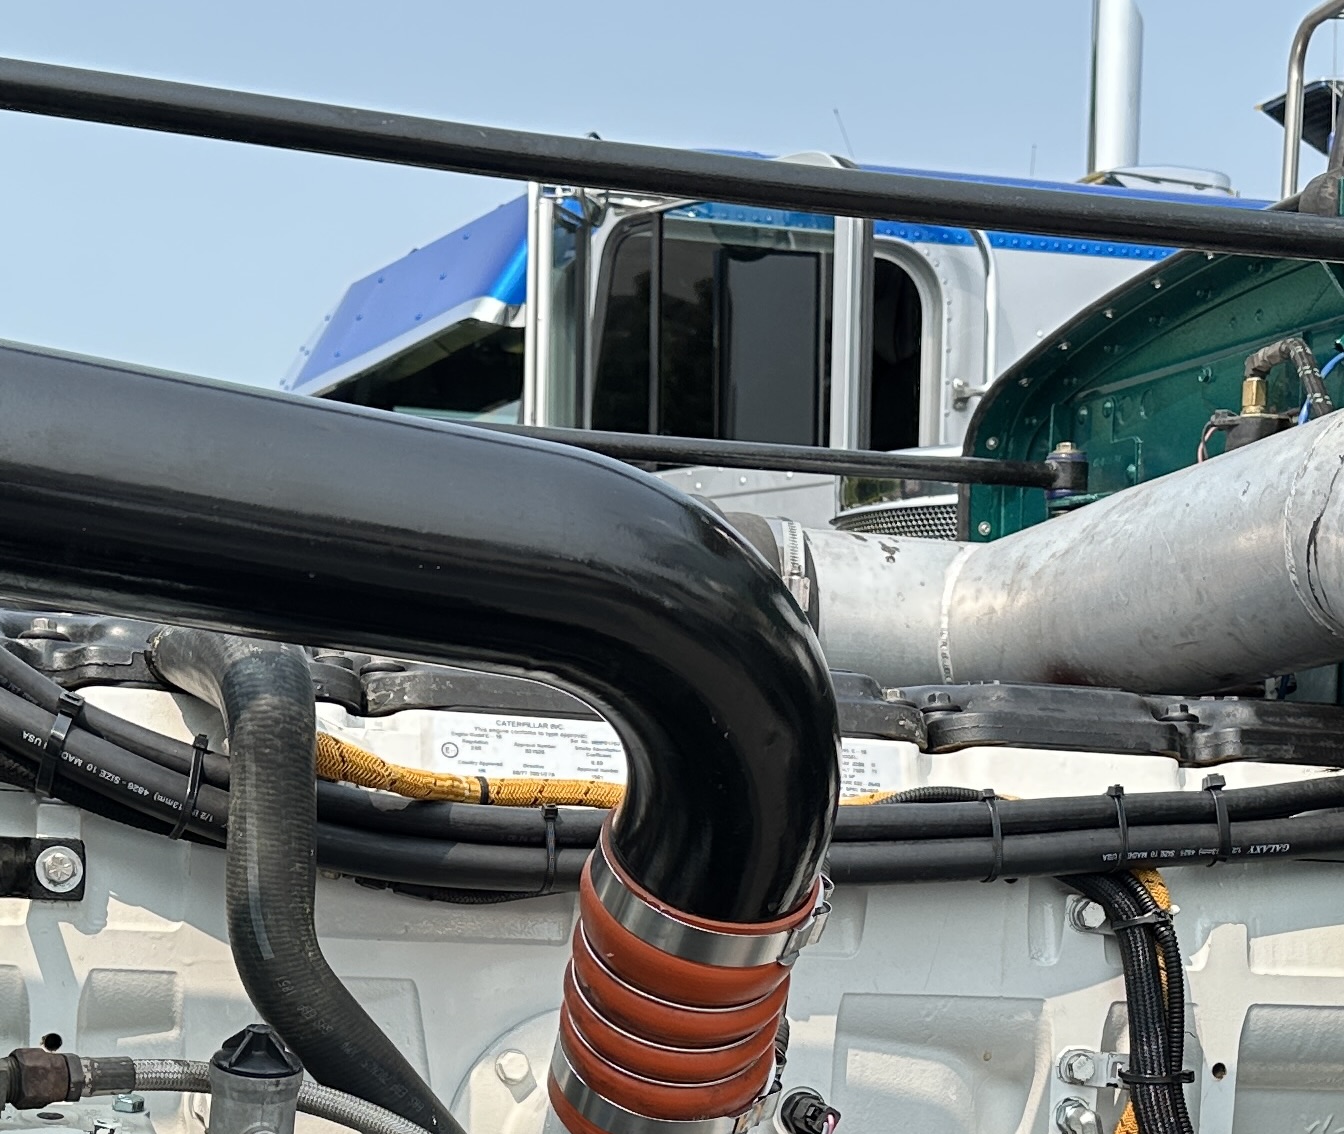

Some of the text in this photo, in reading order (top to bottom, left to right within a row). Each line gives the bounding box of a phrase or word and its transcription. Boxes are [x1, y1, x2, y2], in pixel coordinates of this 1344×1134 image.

[496, 719, 549, 729] CATERPILLAR
[21, 730, 42, 747] USA
[61, 751, 84, 768] MAD
[86, 763, 98, 776] 10
[99, 769, 121, 785] SIZE
[1246, 843, 1291, 855] GALAXY
